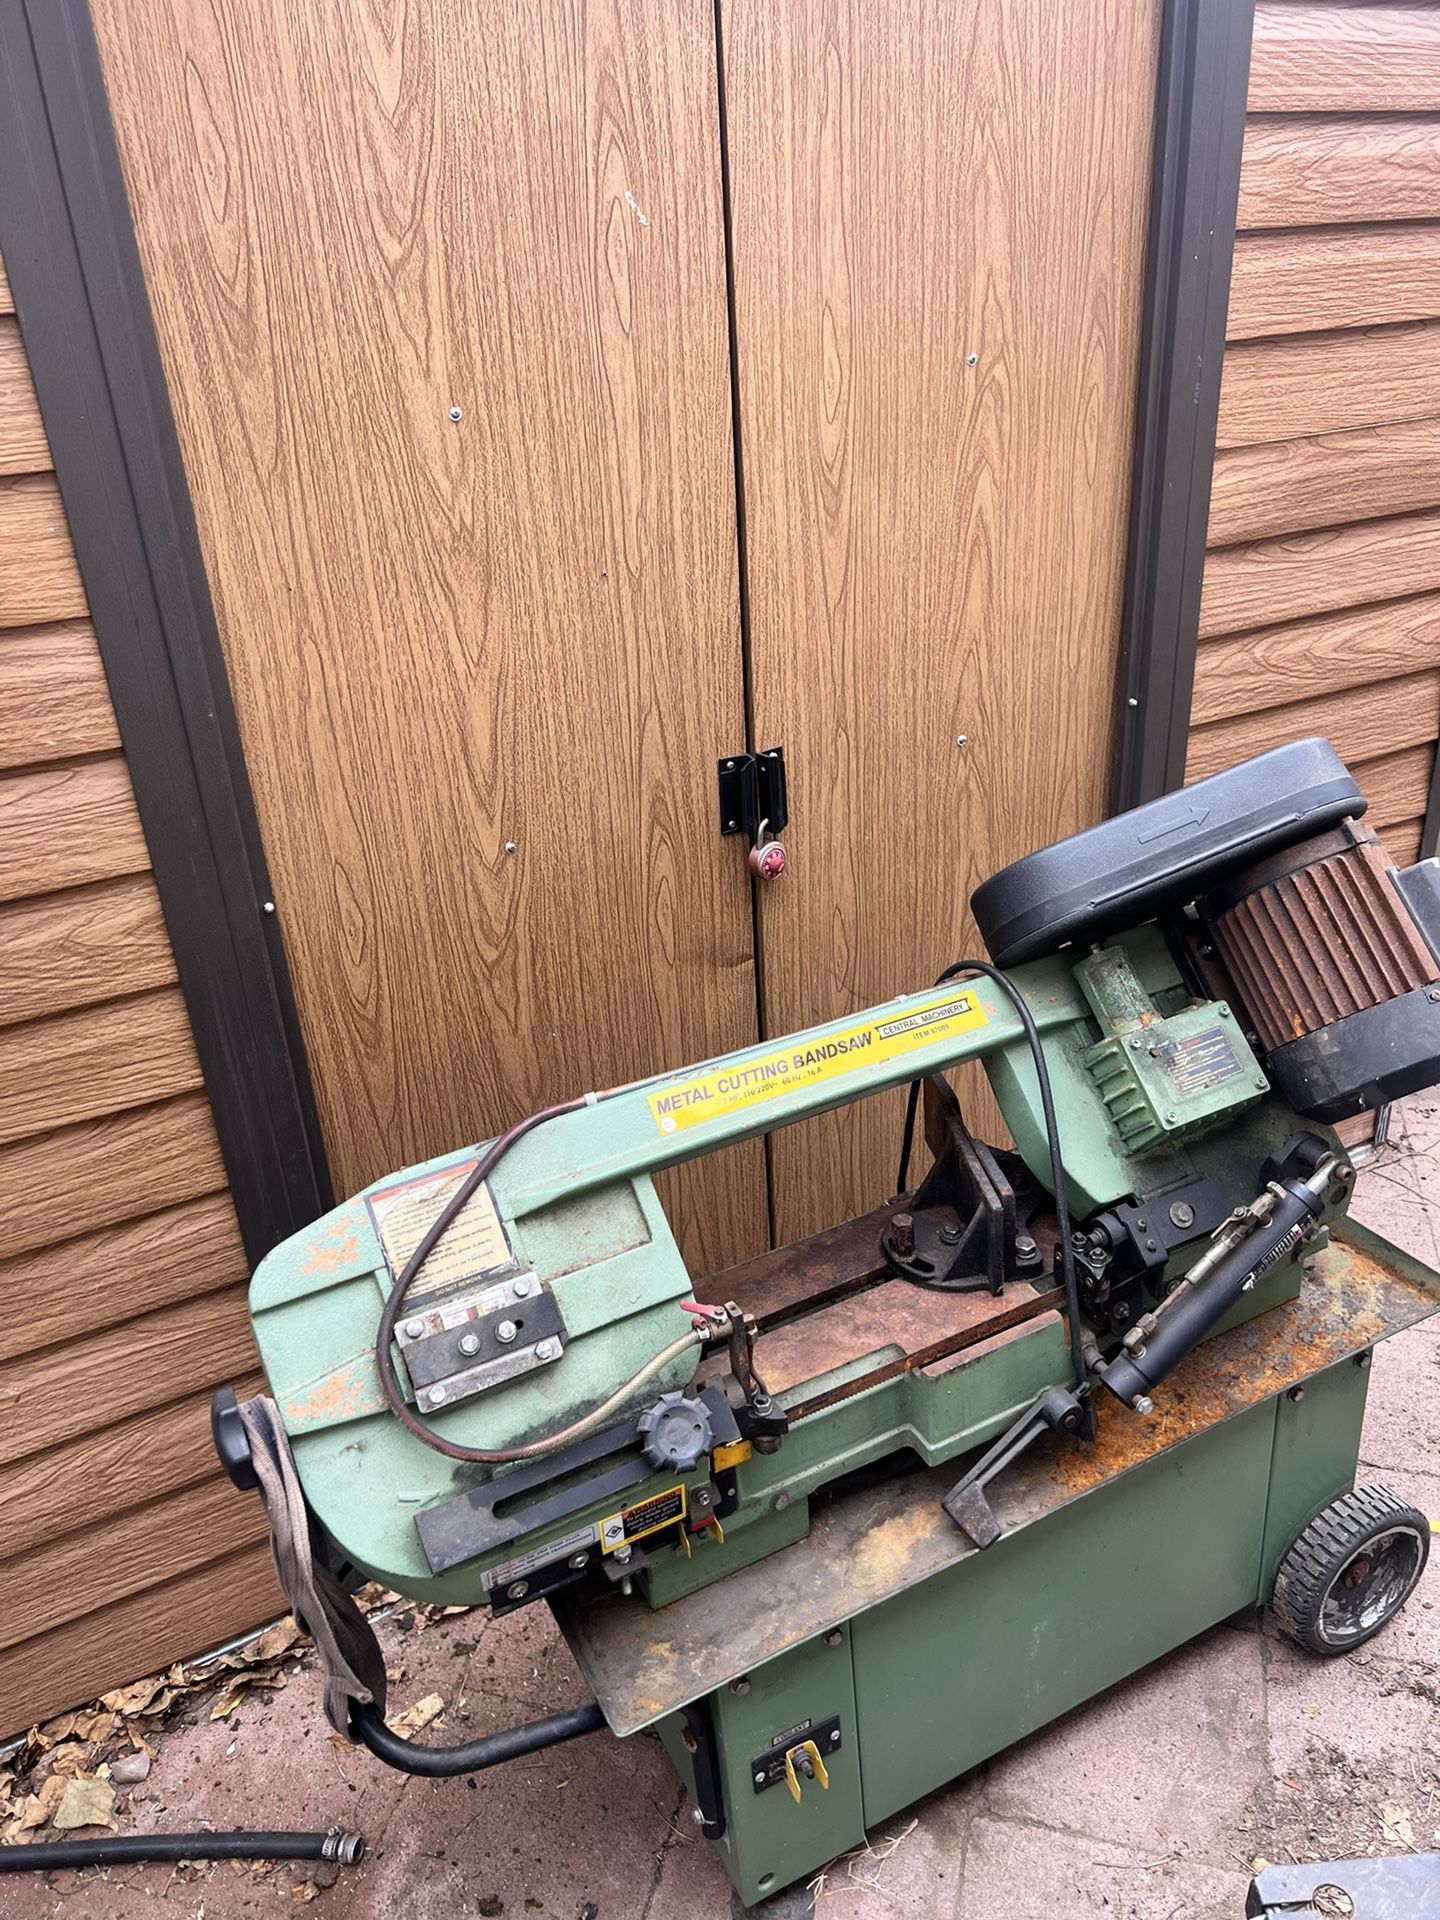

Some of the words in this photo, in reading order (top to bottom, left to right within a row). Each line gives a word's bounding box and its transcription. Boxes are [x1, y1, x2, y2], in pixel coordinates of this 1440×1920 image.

[882, 1018, 919, 1036] CENTRAL
[920, 1003, 965, 1023] MACHINERY
[912, 1029, 930, 1040] ITEM
[656, 1085, 714, 1115] METAL
[717, 1060, 789, 1093] CUTTING
[792, 1031, 872, 1070] BANDSAW
[781, 1078, 791, 1086] 60
[807, 1068, 816, 1077] 16
[816, 1066, 823, 1074] A
